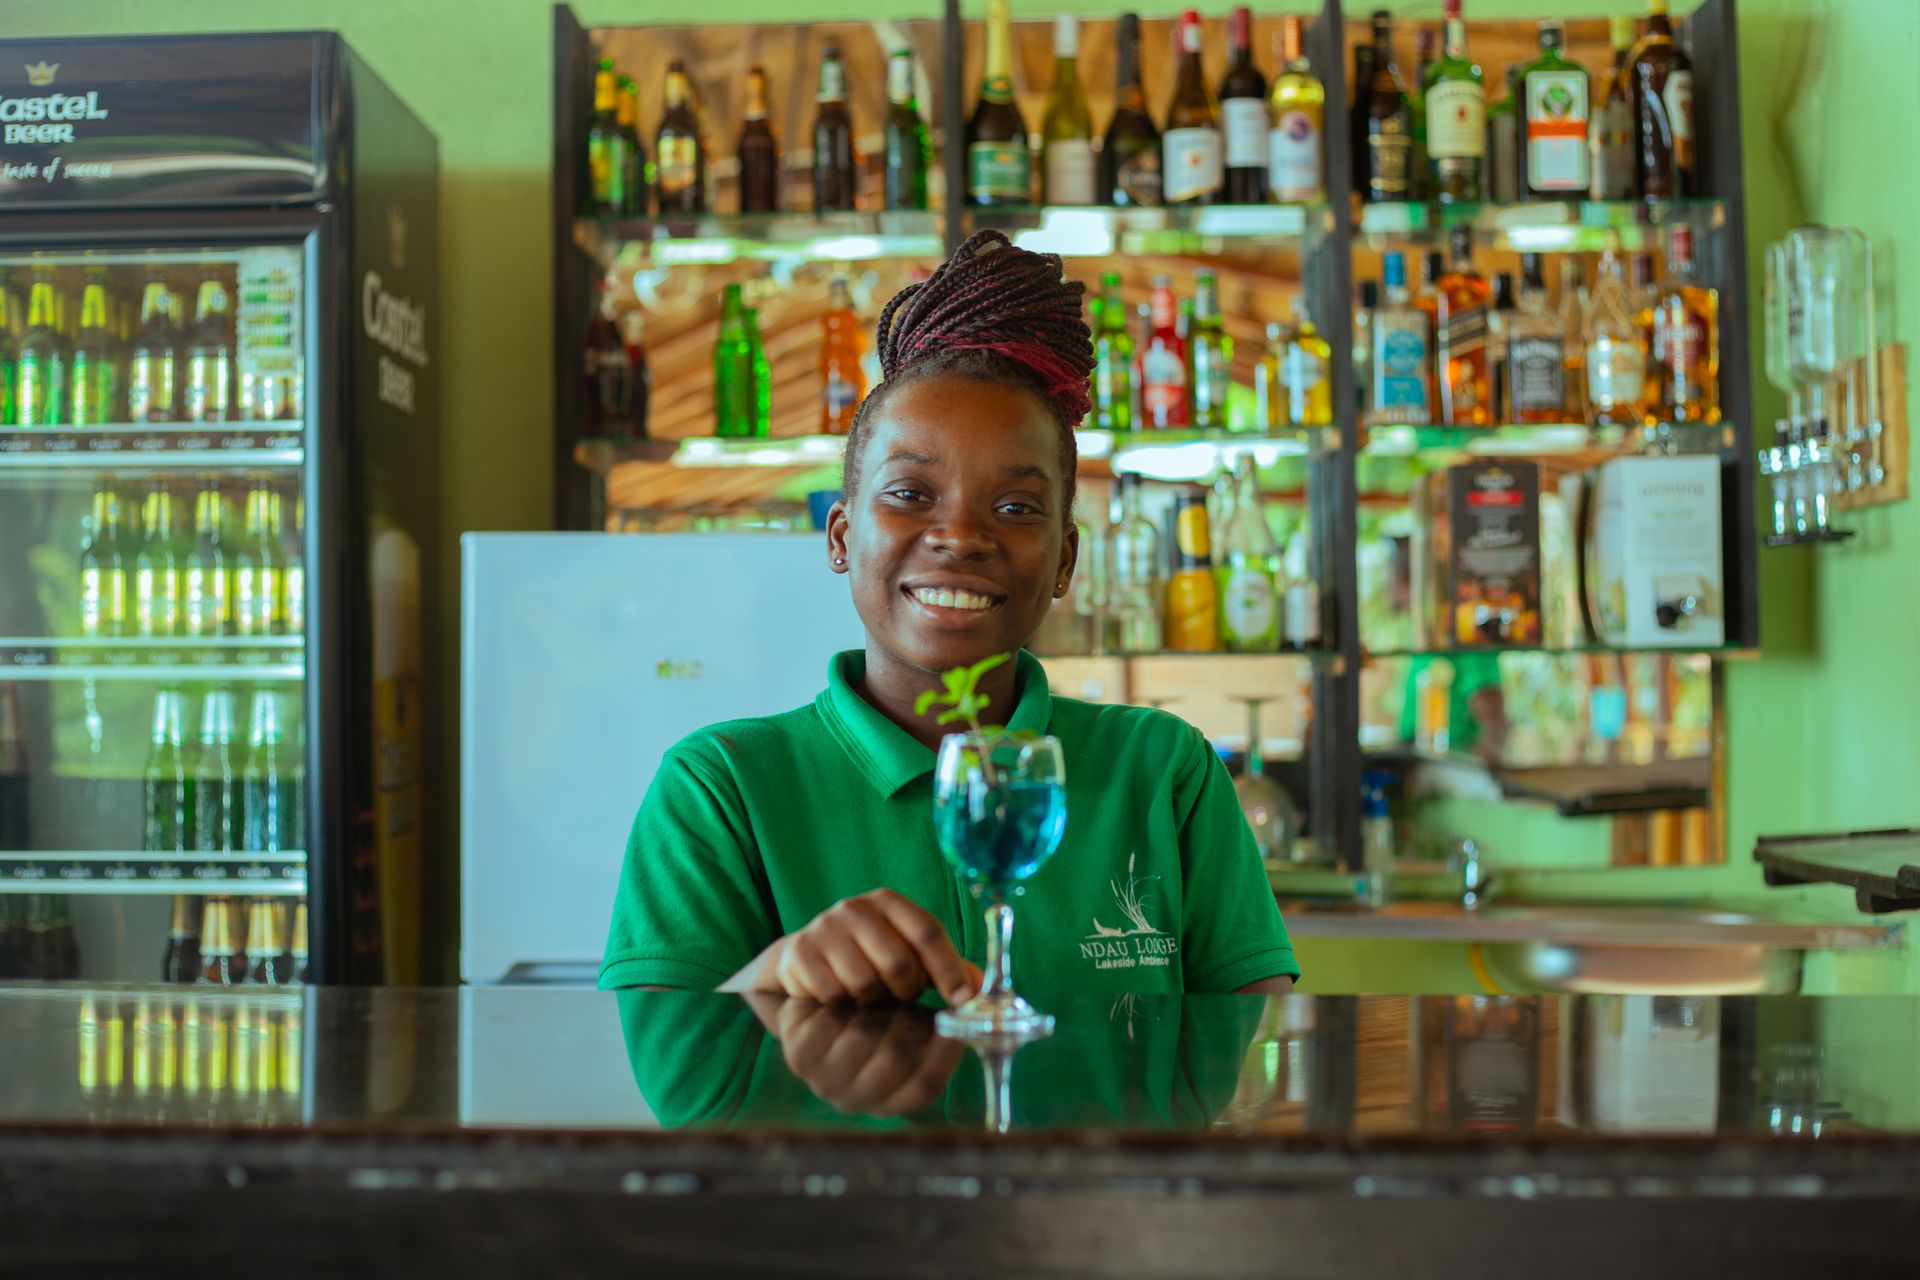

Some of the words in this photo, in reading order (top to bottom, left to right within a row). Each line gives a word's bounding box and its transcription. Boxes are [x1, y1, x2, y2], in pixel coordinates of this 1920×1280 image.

[42, 157, 62, 183] of
[1079, 942, 1128, 958] NDAU
[1135, 937, 1178, 954] LODGE
[1096, 957, 1135, 969] Lakeside
